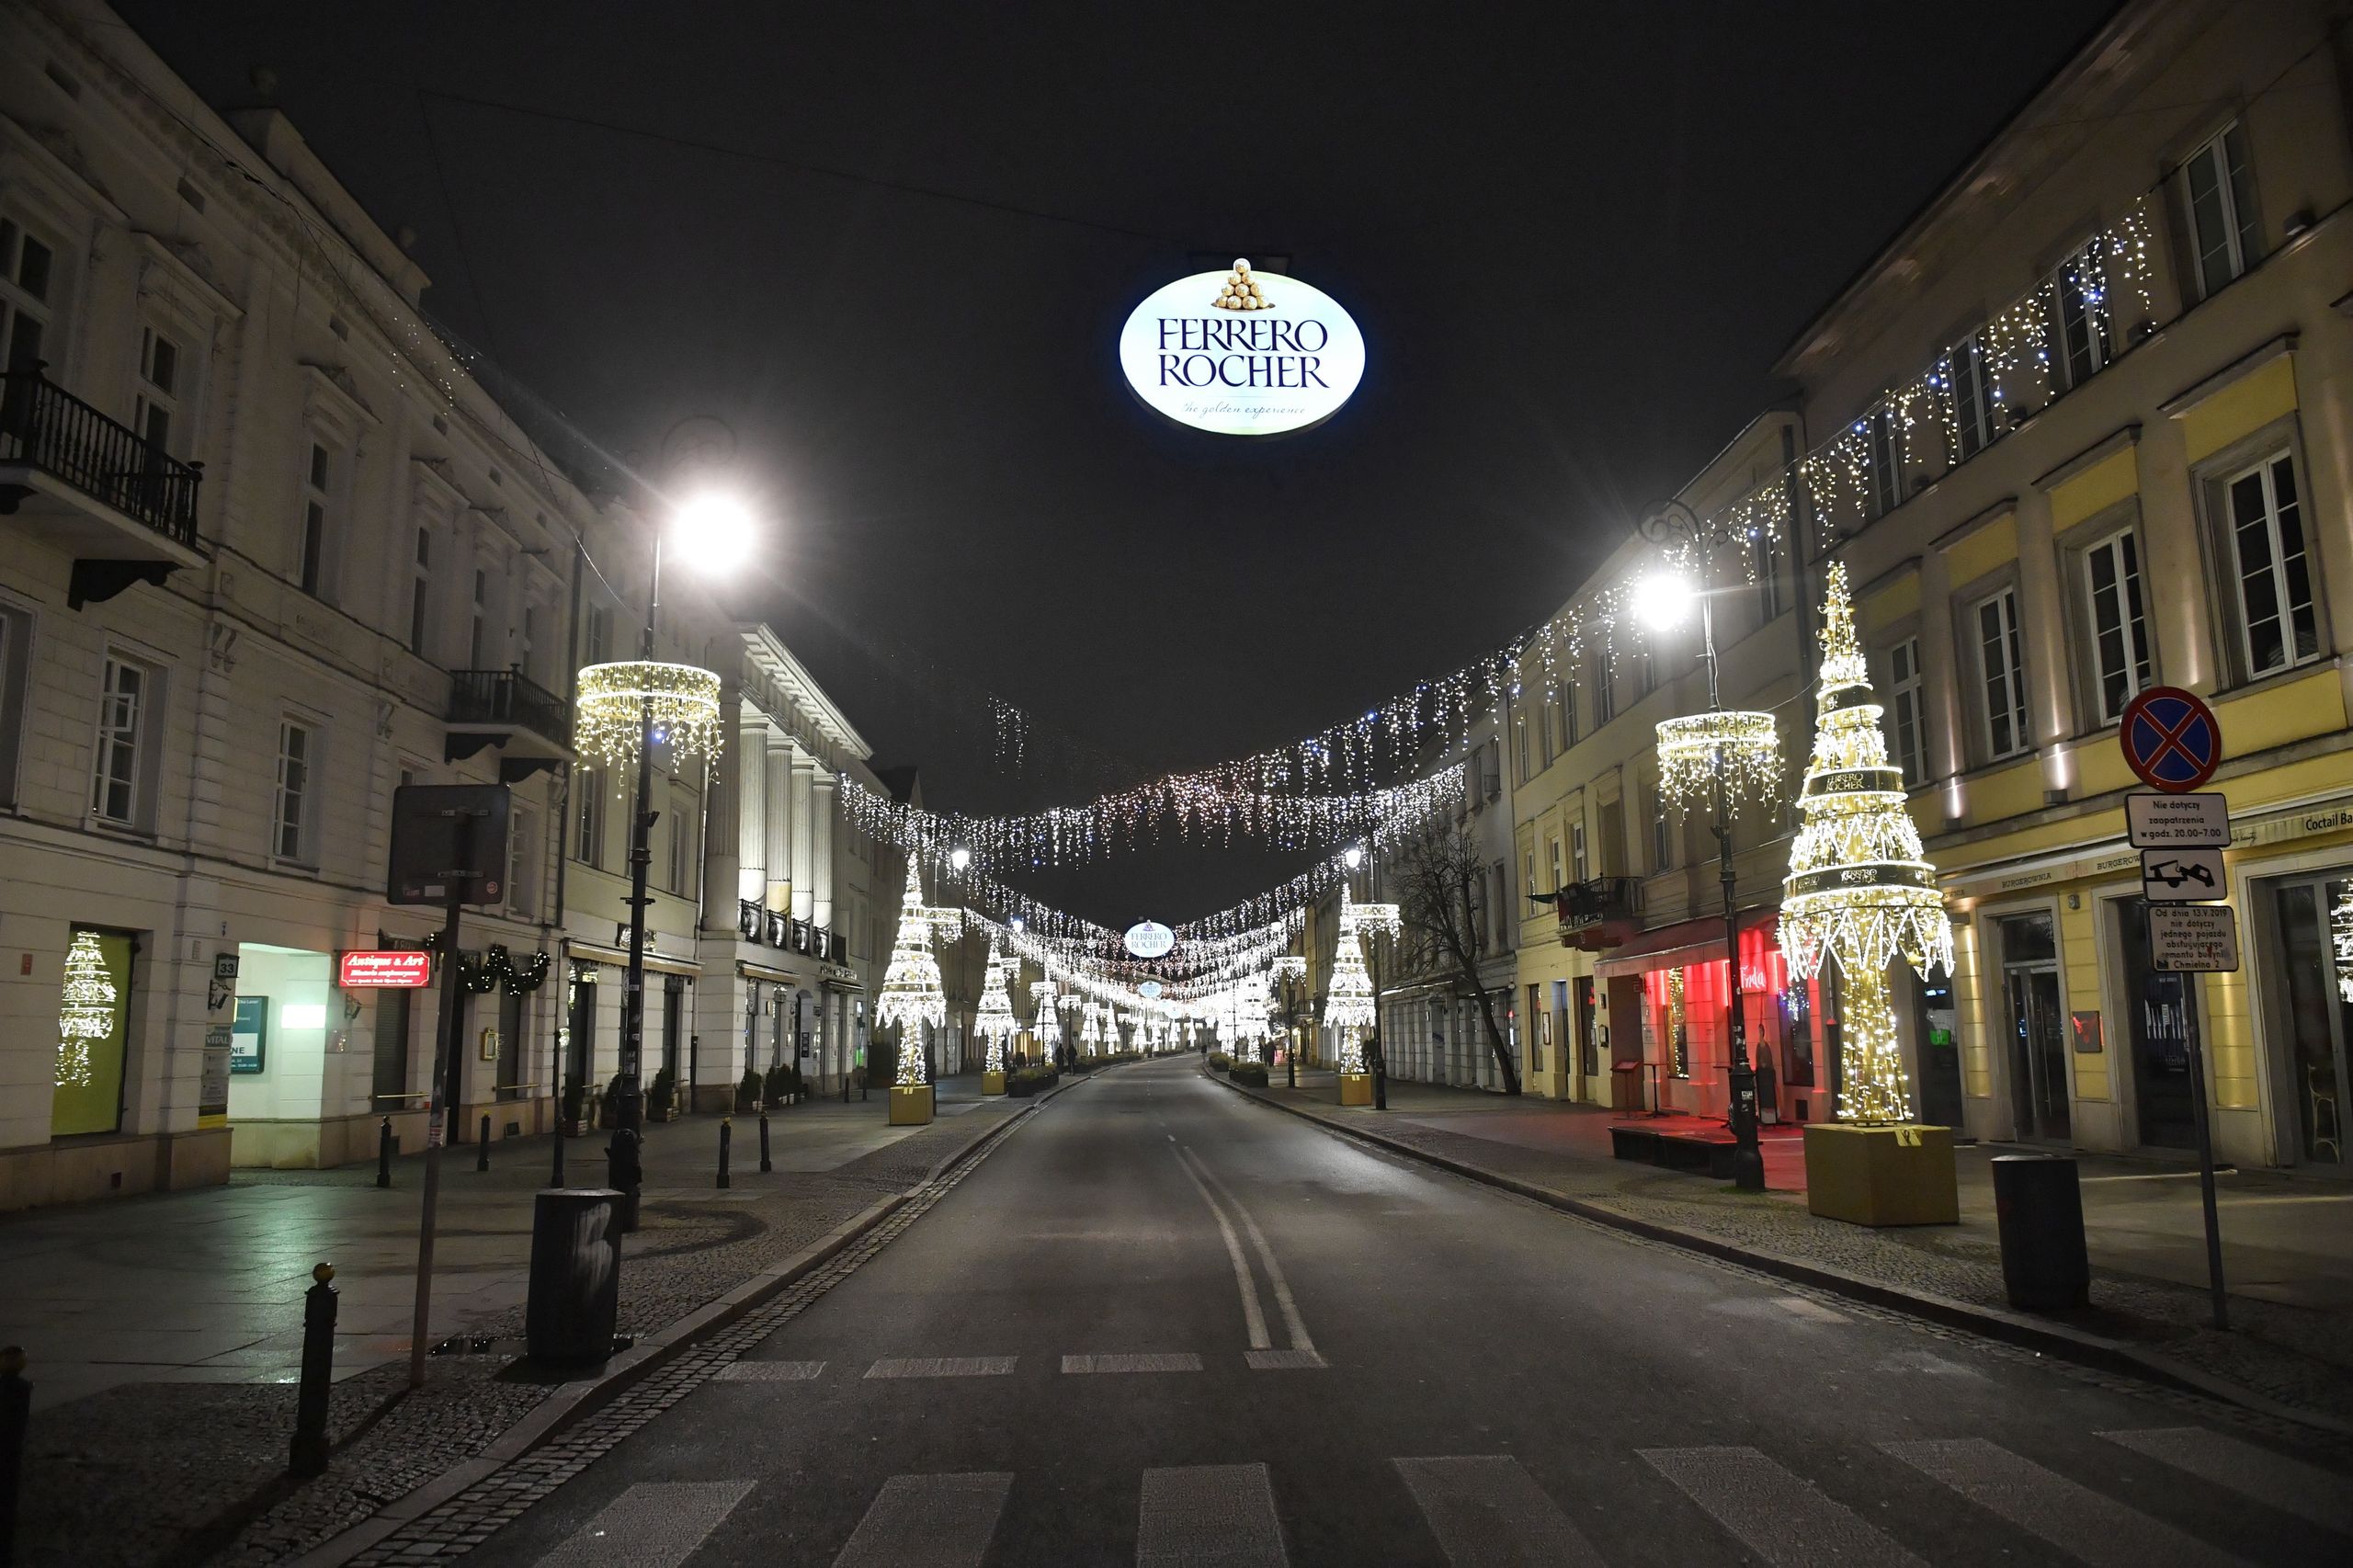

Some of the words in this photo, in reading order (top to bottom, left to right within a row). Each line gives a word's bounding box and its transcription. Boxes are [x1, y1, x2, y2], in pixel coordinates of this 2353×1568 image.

[1157, 318, 1328, 352] FERRERO
[1158, 354, 1330, 388] ROCHER
[1200, 402, 1241, 419] golden
[1245, 405, 1305, 419] experience
[1824, 781, 1865, 792] ROCHER
[2153, 801, 2167, 809] Nie
[2169, 801, 2200, 811] dotyczy
[2149, 817, 2205, 826] zaopatrzenia
[2305, 813, 2338, 830] Coctail
[2175, 829, 2222, 838] 20.00-7.00
[2001, 872, 2052, 888] BURGEROWNIA
[2155, 909, 2167, 917] Od
[2171, 909, 2189, 917] dnia
[2187, 919, 2215, 929] dotyczy
[1131, 932, 1167, 940] FERRERO
[2161, 930, 2192, 939] jednego
[2197, 929, 2226, 941] pojazdu
[1131, 940, 1166, 949] ROCHER
[403, 955, 425, 966] Art
[2174, 960, 2211, 969] Chmielna
[2215, 960, 2220, 968] 2
[220, 963, 234, 973] 33
